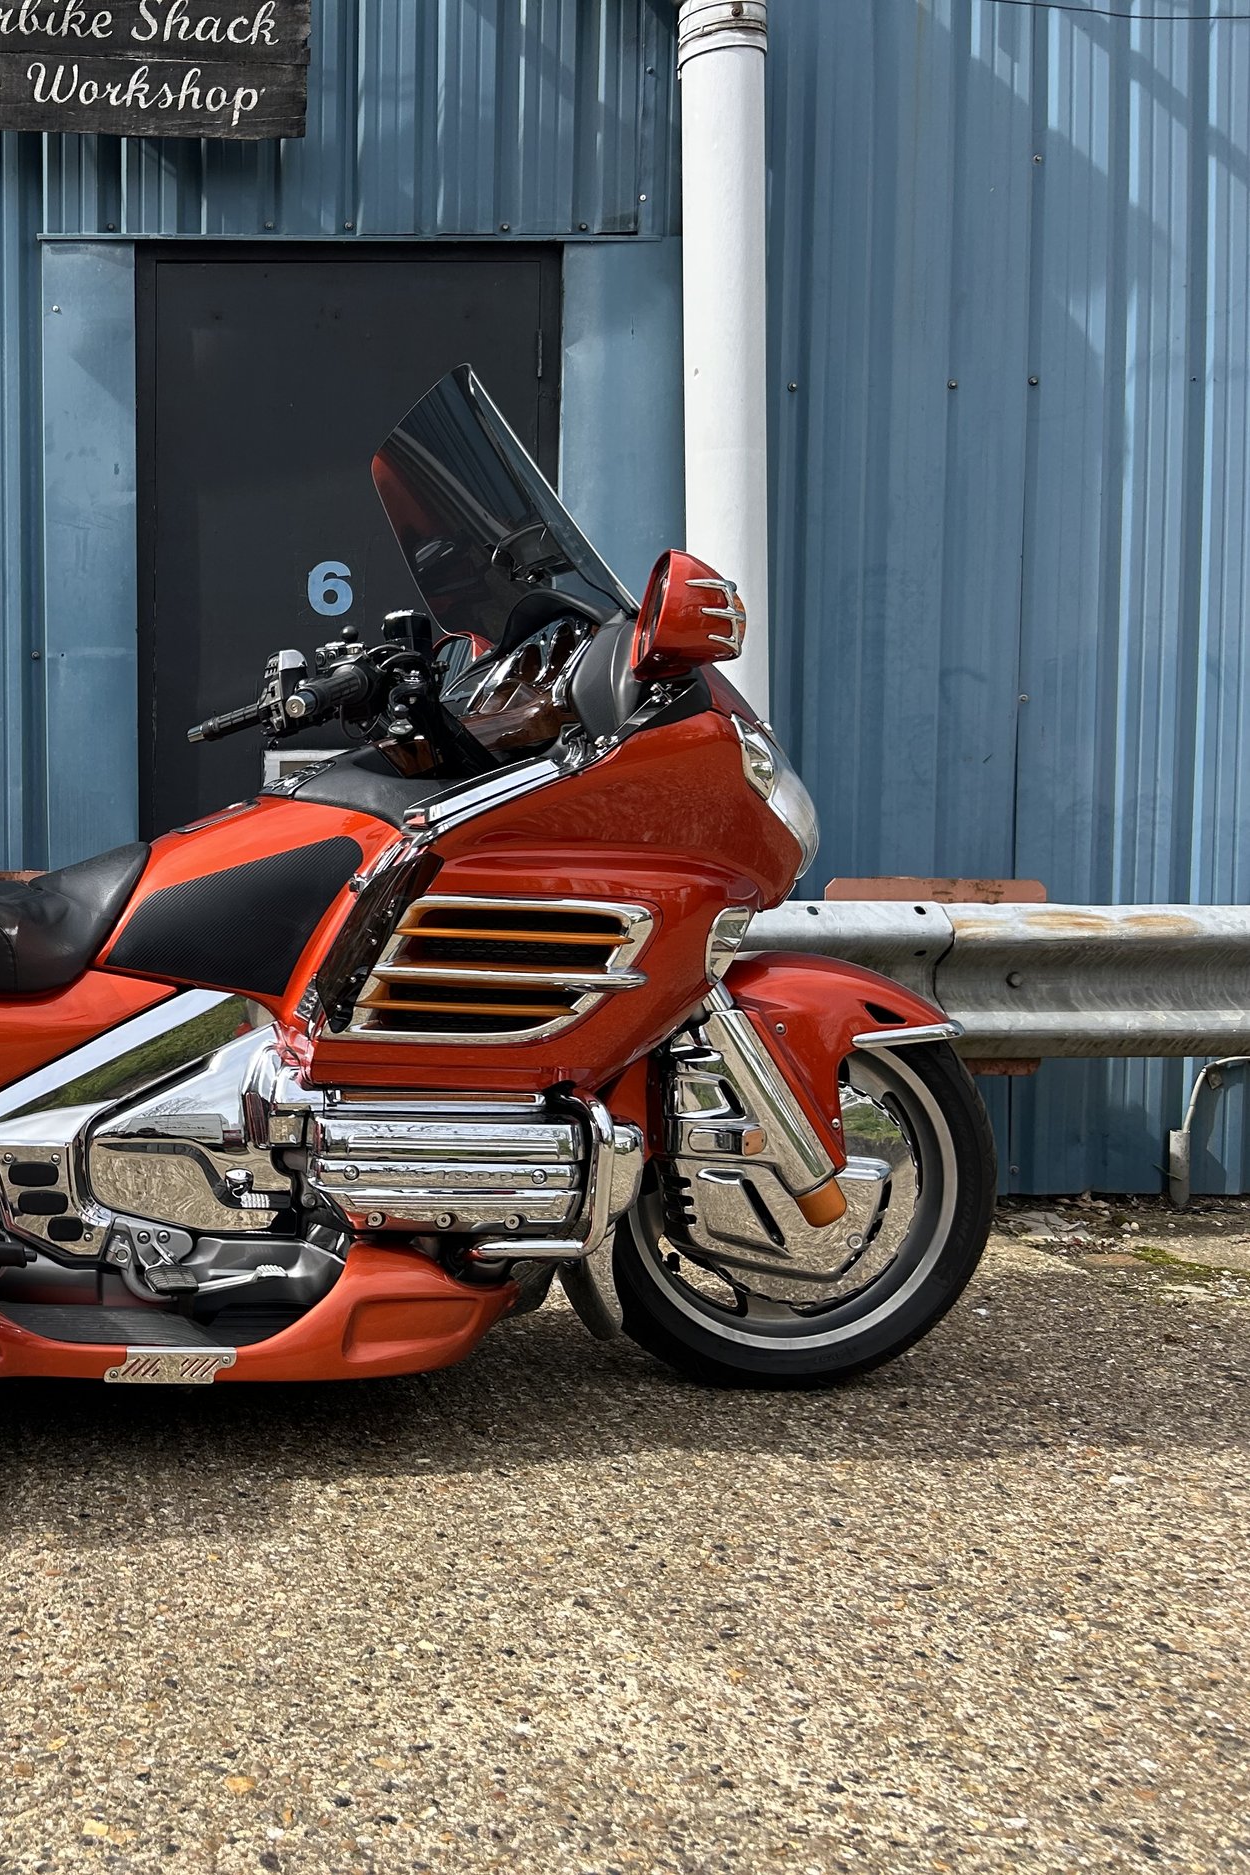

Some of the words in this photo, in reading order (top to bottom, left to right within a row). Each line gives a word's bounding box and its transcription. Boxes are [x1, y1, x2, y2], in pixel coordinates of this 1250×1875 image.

[131, 0, 279, 46] Shack
[27, 62, 260, 126] Workshop
[308, 561, 353, 616] 6
